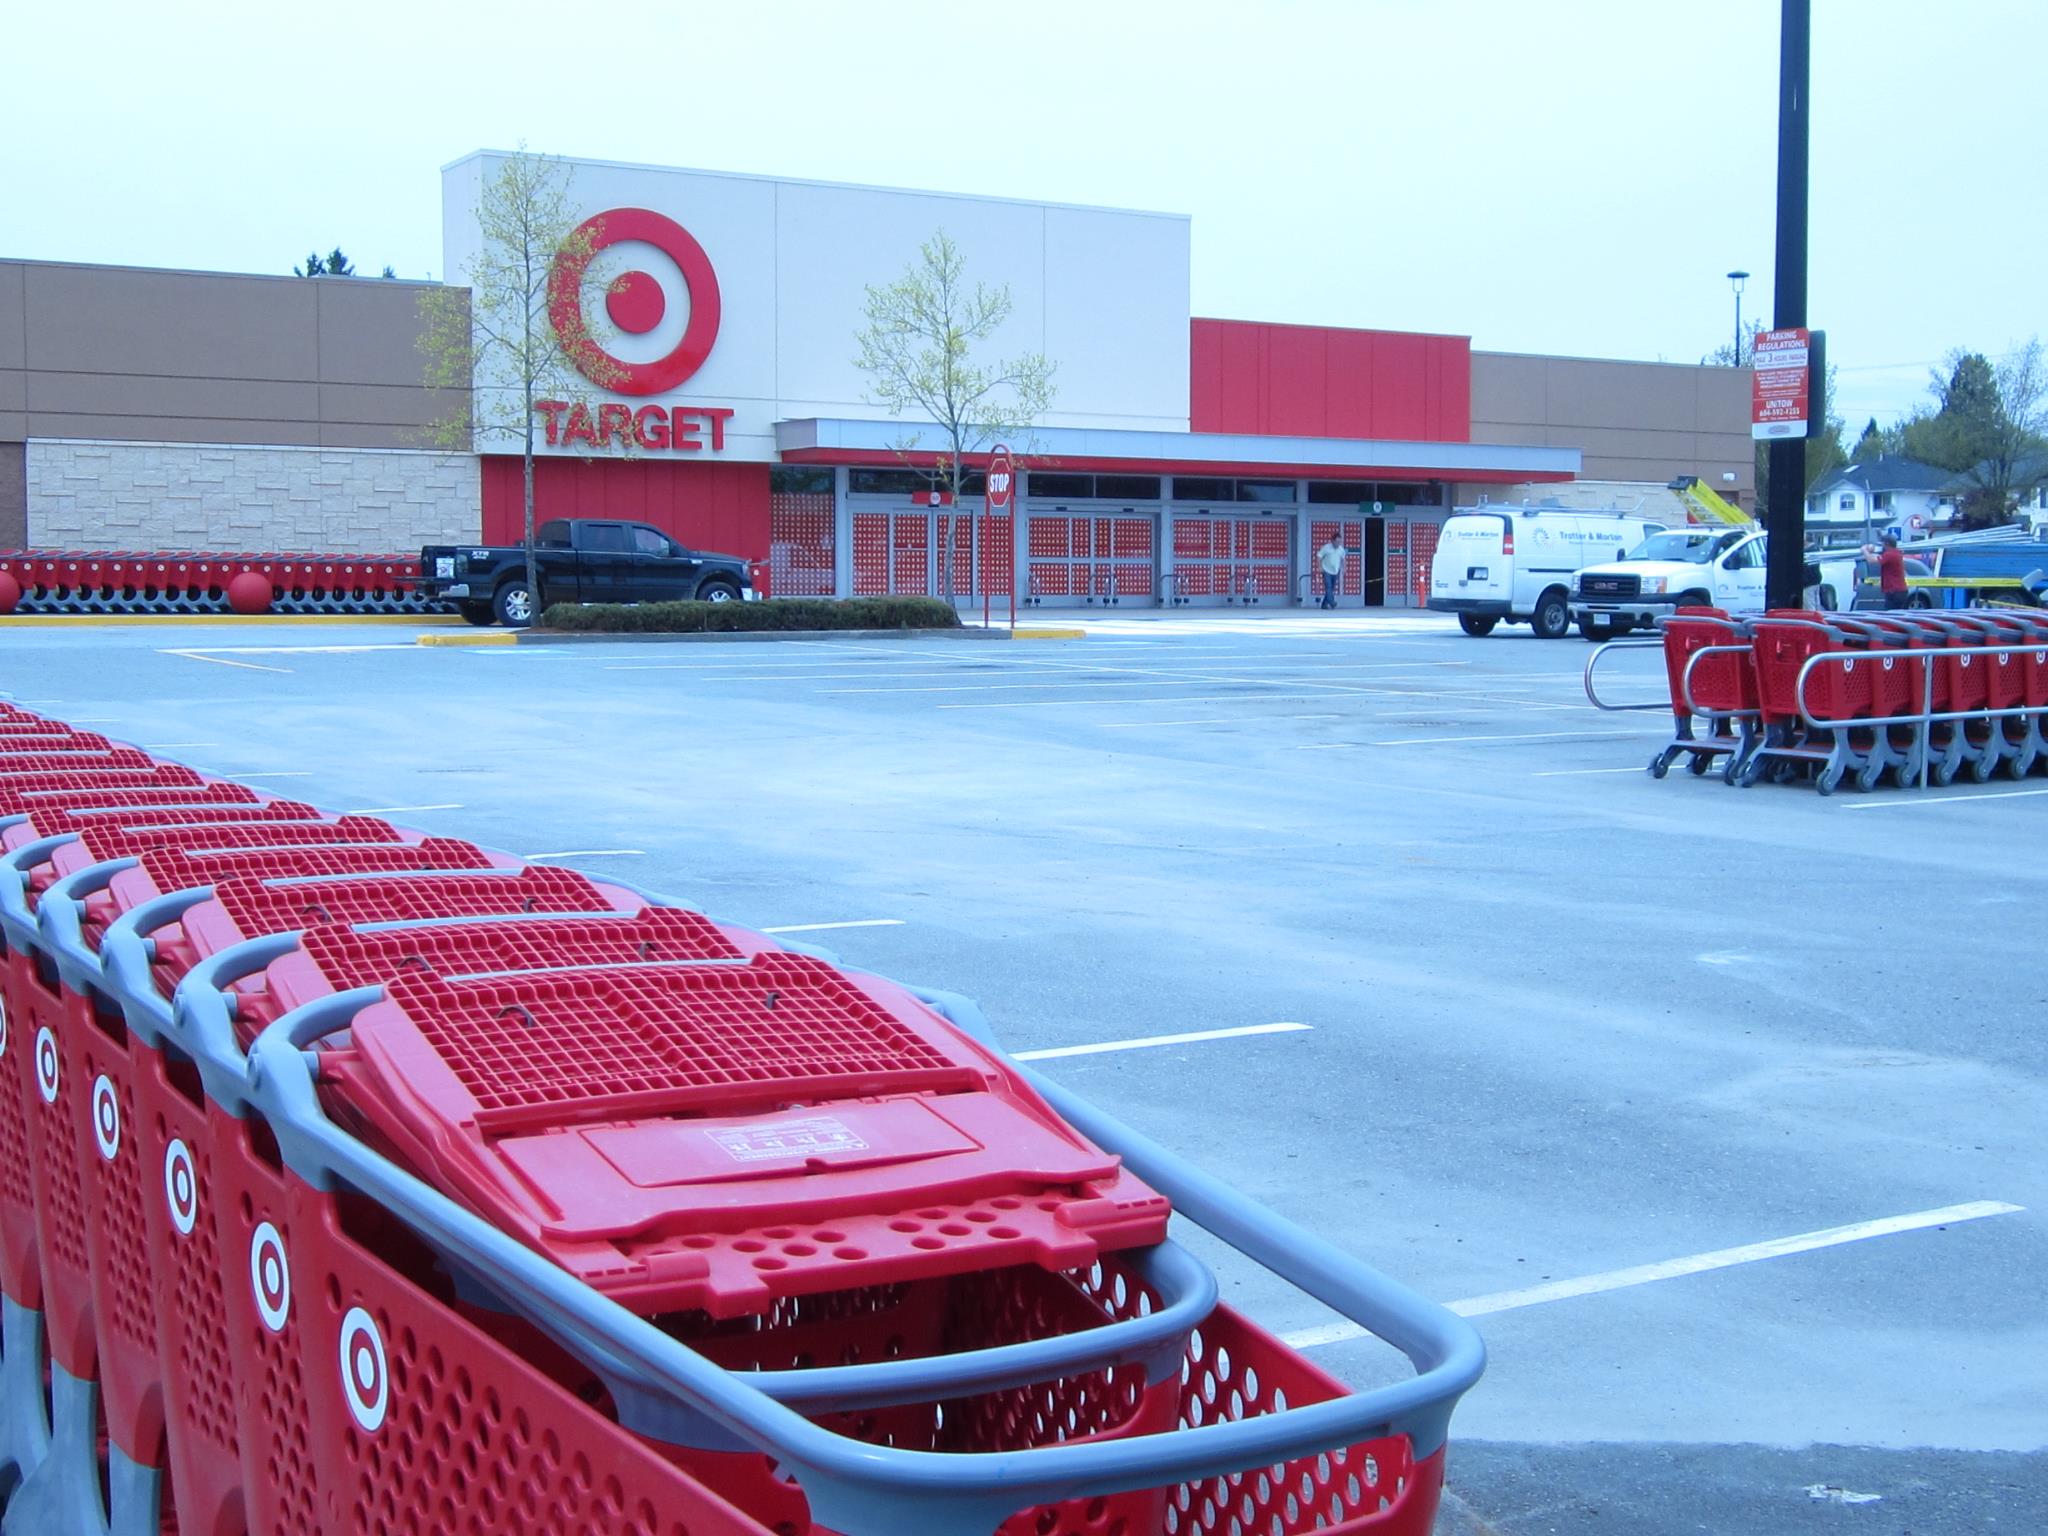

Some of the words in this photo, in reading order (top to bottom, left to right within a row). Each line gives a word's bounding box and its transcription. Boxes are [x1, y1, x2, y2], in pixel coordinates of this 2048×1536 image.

[1766, 331, 1797, 342] PARKING
[1757, 339, 1805, 351] REGULATIONS
[534, 400, 734, 450] TARGET
[990, 473, 1010, 493] STOP
[1560, 531, 1586, 540] Trotter
[1596, 532, 1623, 541] Morton
[1594, 582, 1618, 590] GMC
